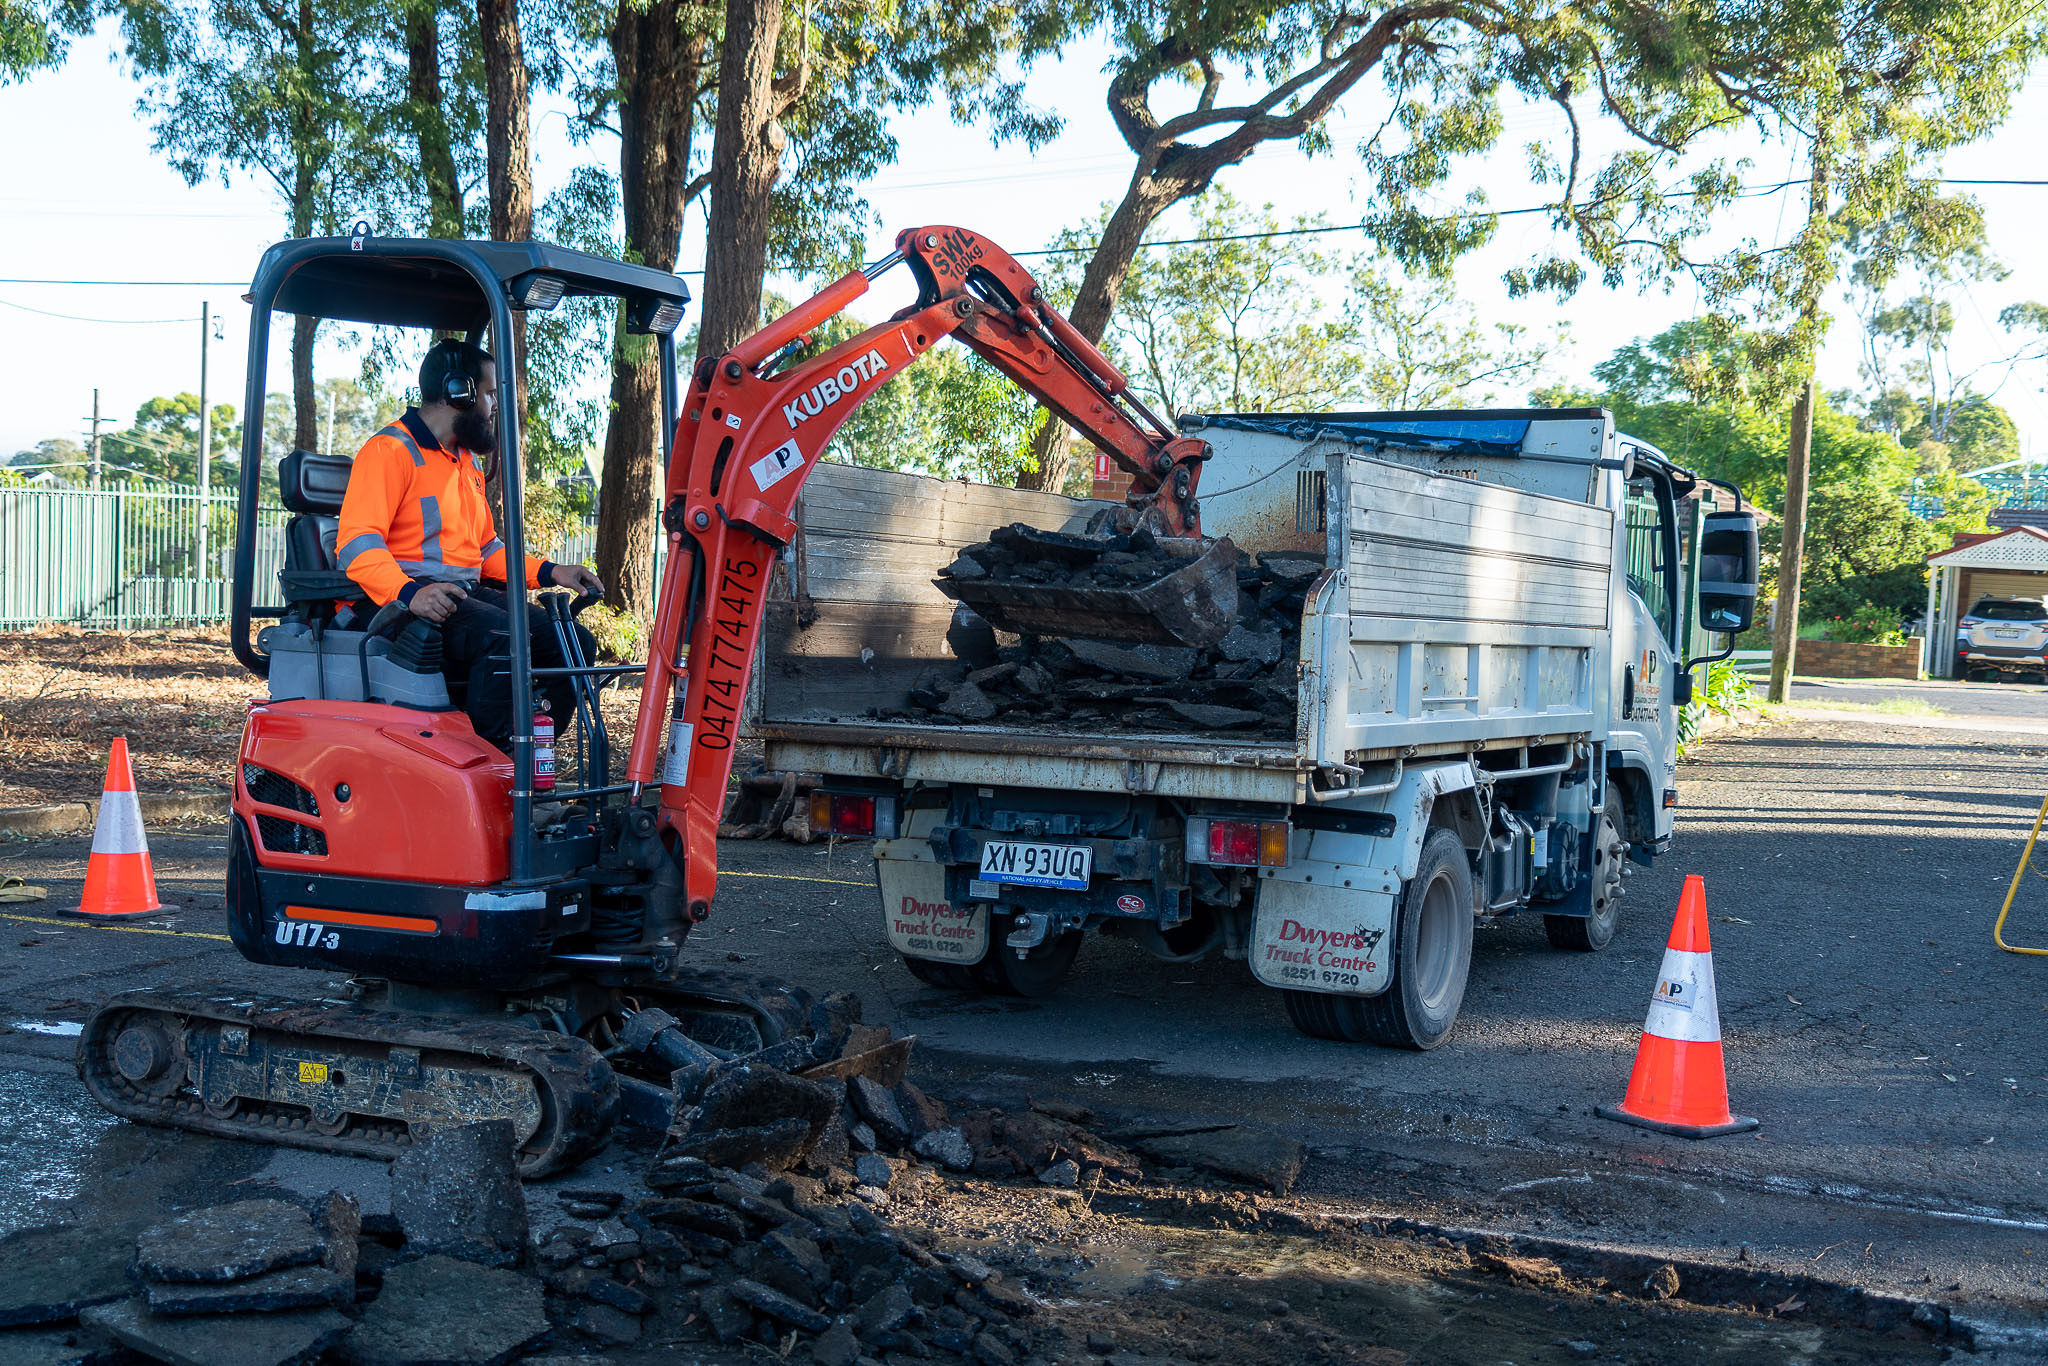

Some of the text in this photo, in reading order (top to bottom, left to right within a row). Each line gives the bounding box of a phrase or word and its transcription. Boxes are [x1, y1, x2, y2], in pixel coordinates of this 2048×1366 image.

[932, 228, 976, 276] SWL
[950, 244, 984, 281] 100kg
[781, 348, 889, 430] KUBOTA
[698, 558, 758, 750] 0474 774475
[275, 921, 340, 950] U17-3
[893, 919, 976, 940] Truck Centre
[907, 938, 934, 951] 4251
[1279, 919, 1366, 951] Dwyers
[1265, 944, 1377, 973] Truck Centre
[1281, 966, 1360, 986] 4251 6720
